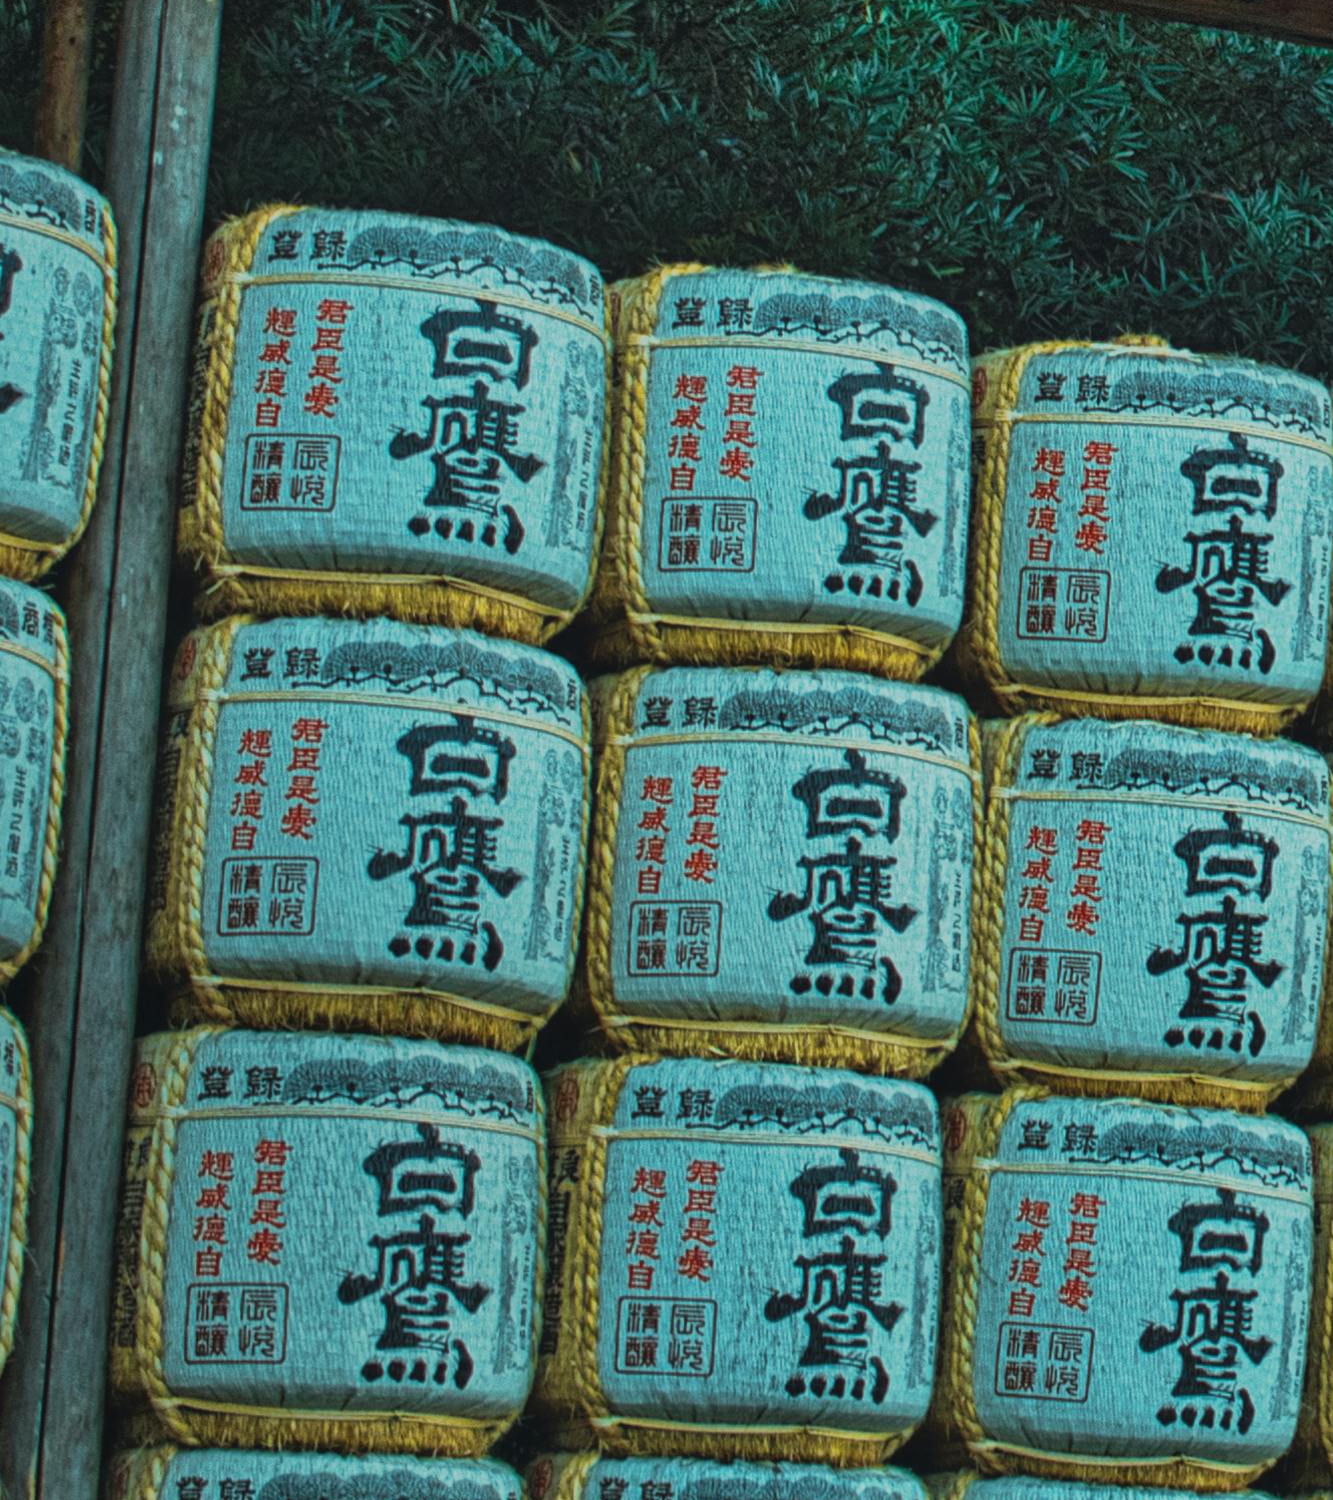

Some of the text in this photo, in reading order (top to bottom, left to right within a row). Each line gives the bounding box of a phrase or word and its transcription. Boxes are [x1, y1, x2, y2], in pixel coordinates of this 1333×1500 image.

[390, 298, 544, 554] 白鷹
[804, 361, 937, 607] 白鷹
[1156, 432, 1290, 674] 白鷹
[368, 713, 522, 972] 白鷹
[768, 748, 917, 1005] 白鷹
[1147, 811, 1283, 1057] 白鷹
[338, 1122, 489, 1389] 白鷹
[765, 1148, 903, 1404] 白鷹
[1139, 1187, 1272, 1434] 白鷹
